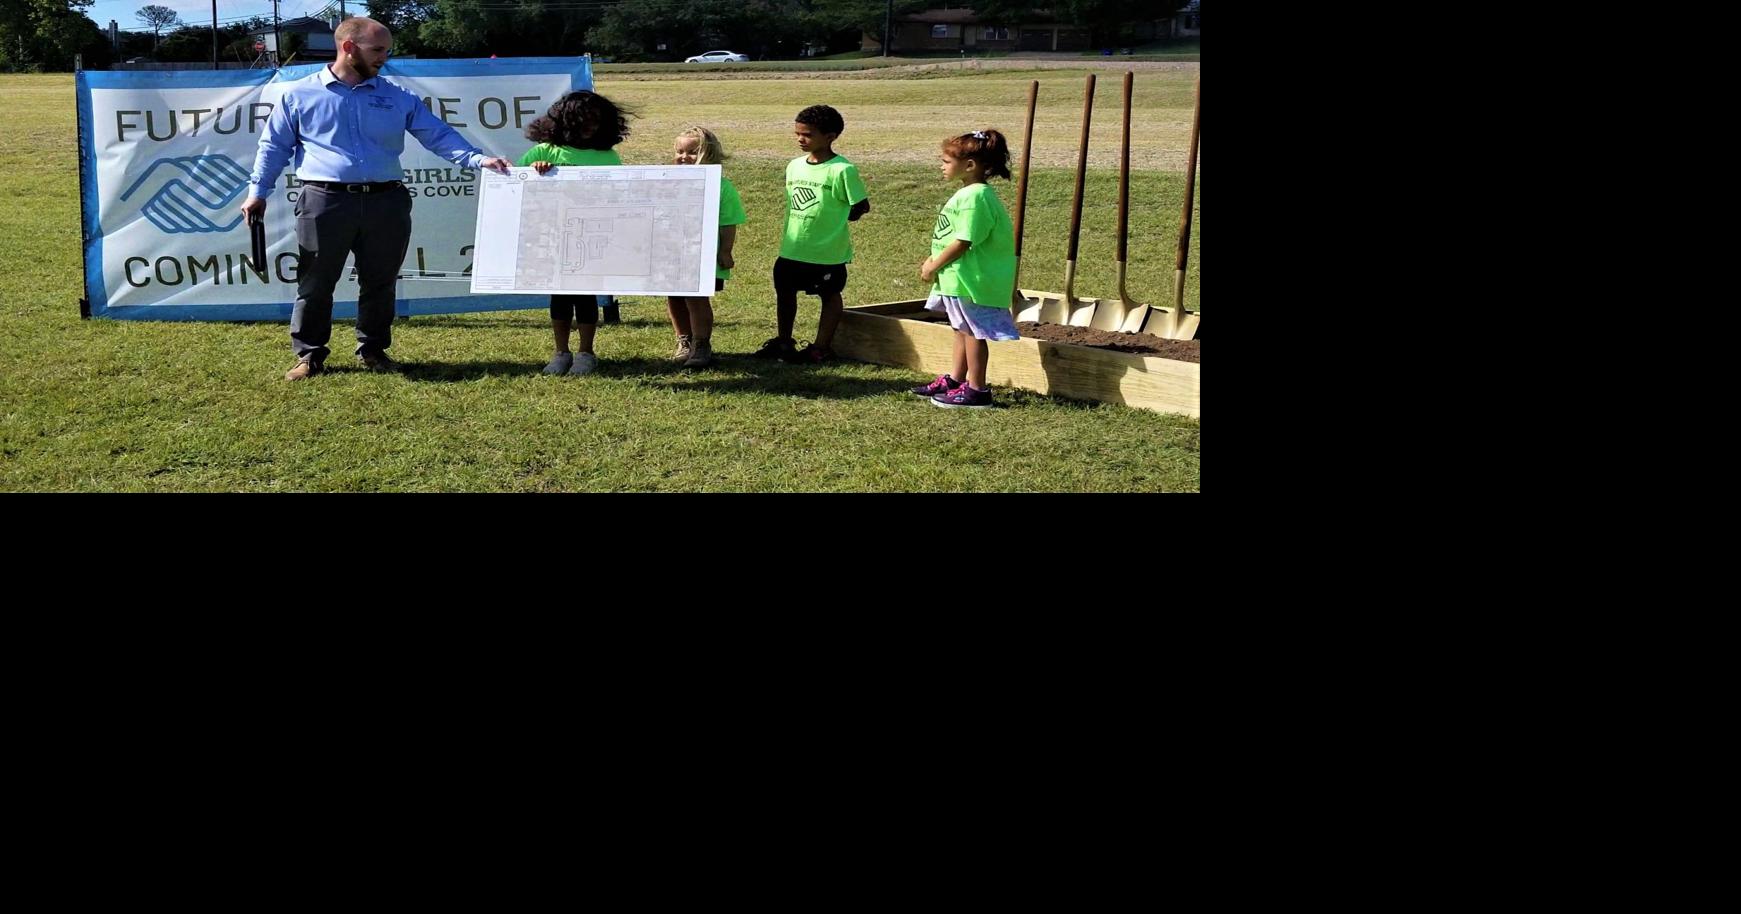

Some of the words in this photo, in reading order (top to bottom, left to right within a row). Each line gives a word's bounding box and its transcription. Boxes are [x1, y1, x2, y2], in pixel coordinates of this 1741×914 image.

[116, 102, 275, 142] FUTUR
[477, 95, 541, 130] OF
[401, 166, 476, 185] GIRLS
[423, 184, 475, 198] COVE
[124, 251, 300, 288] COMING
